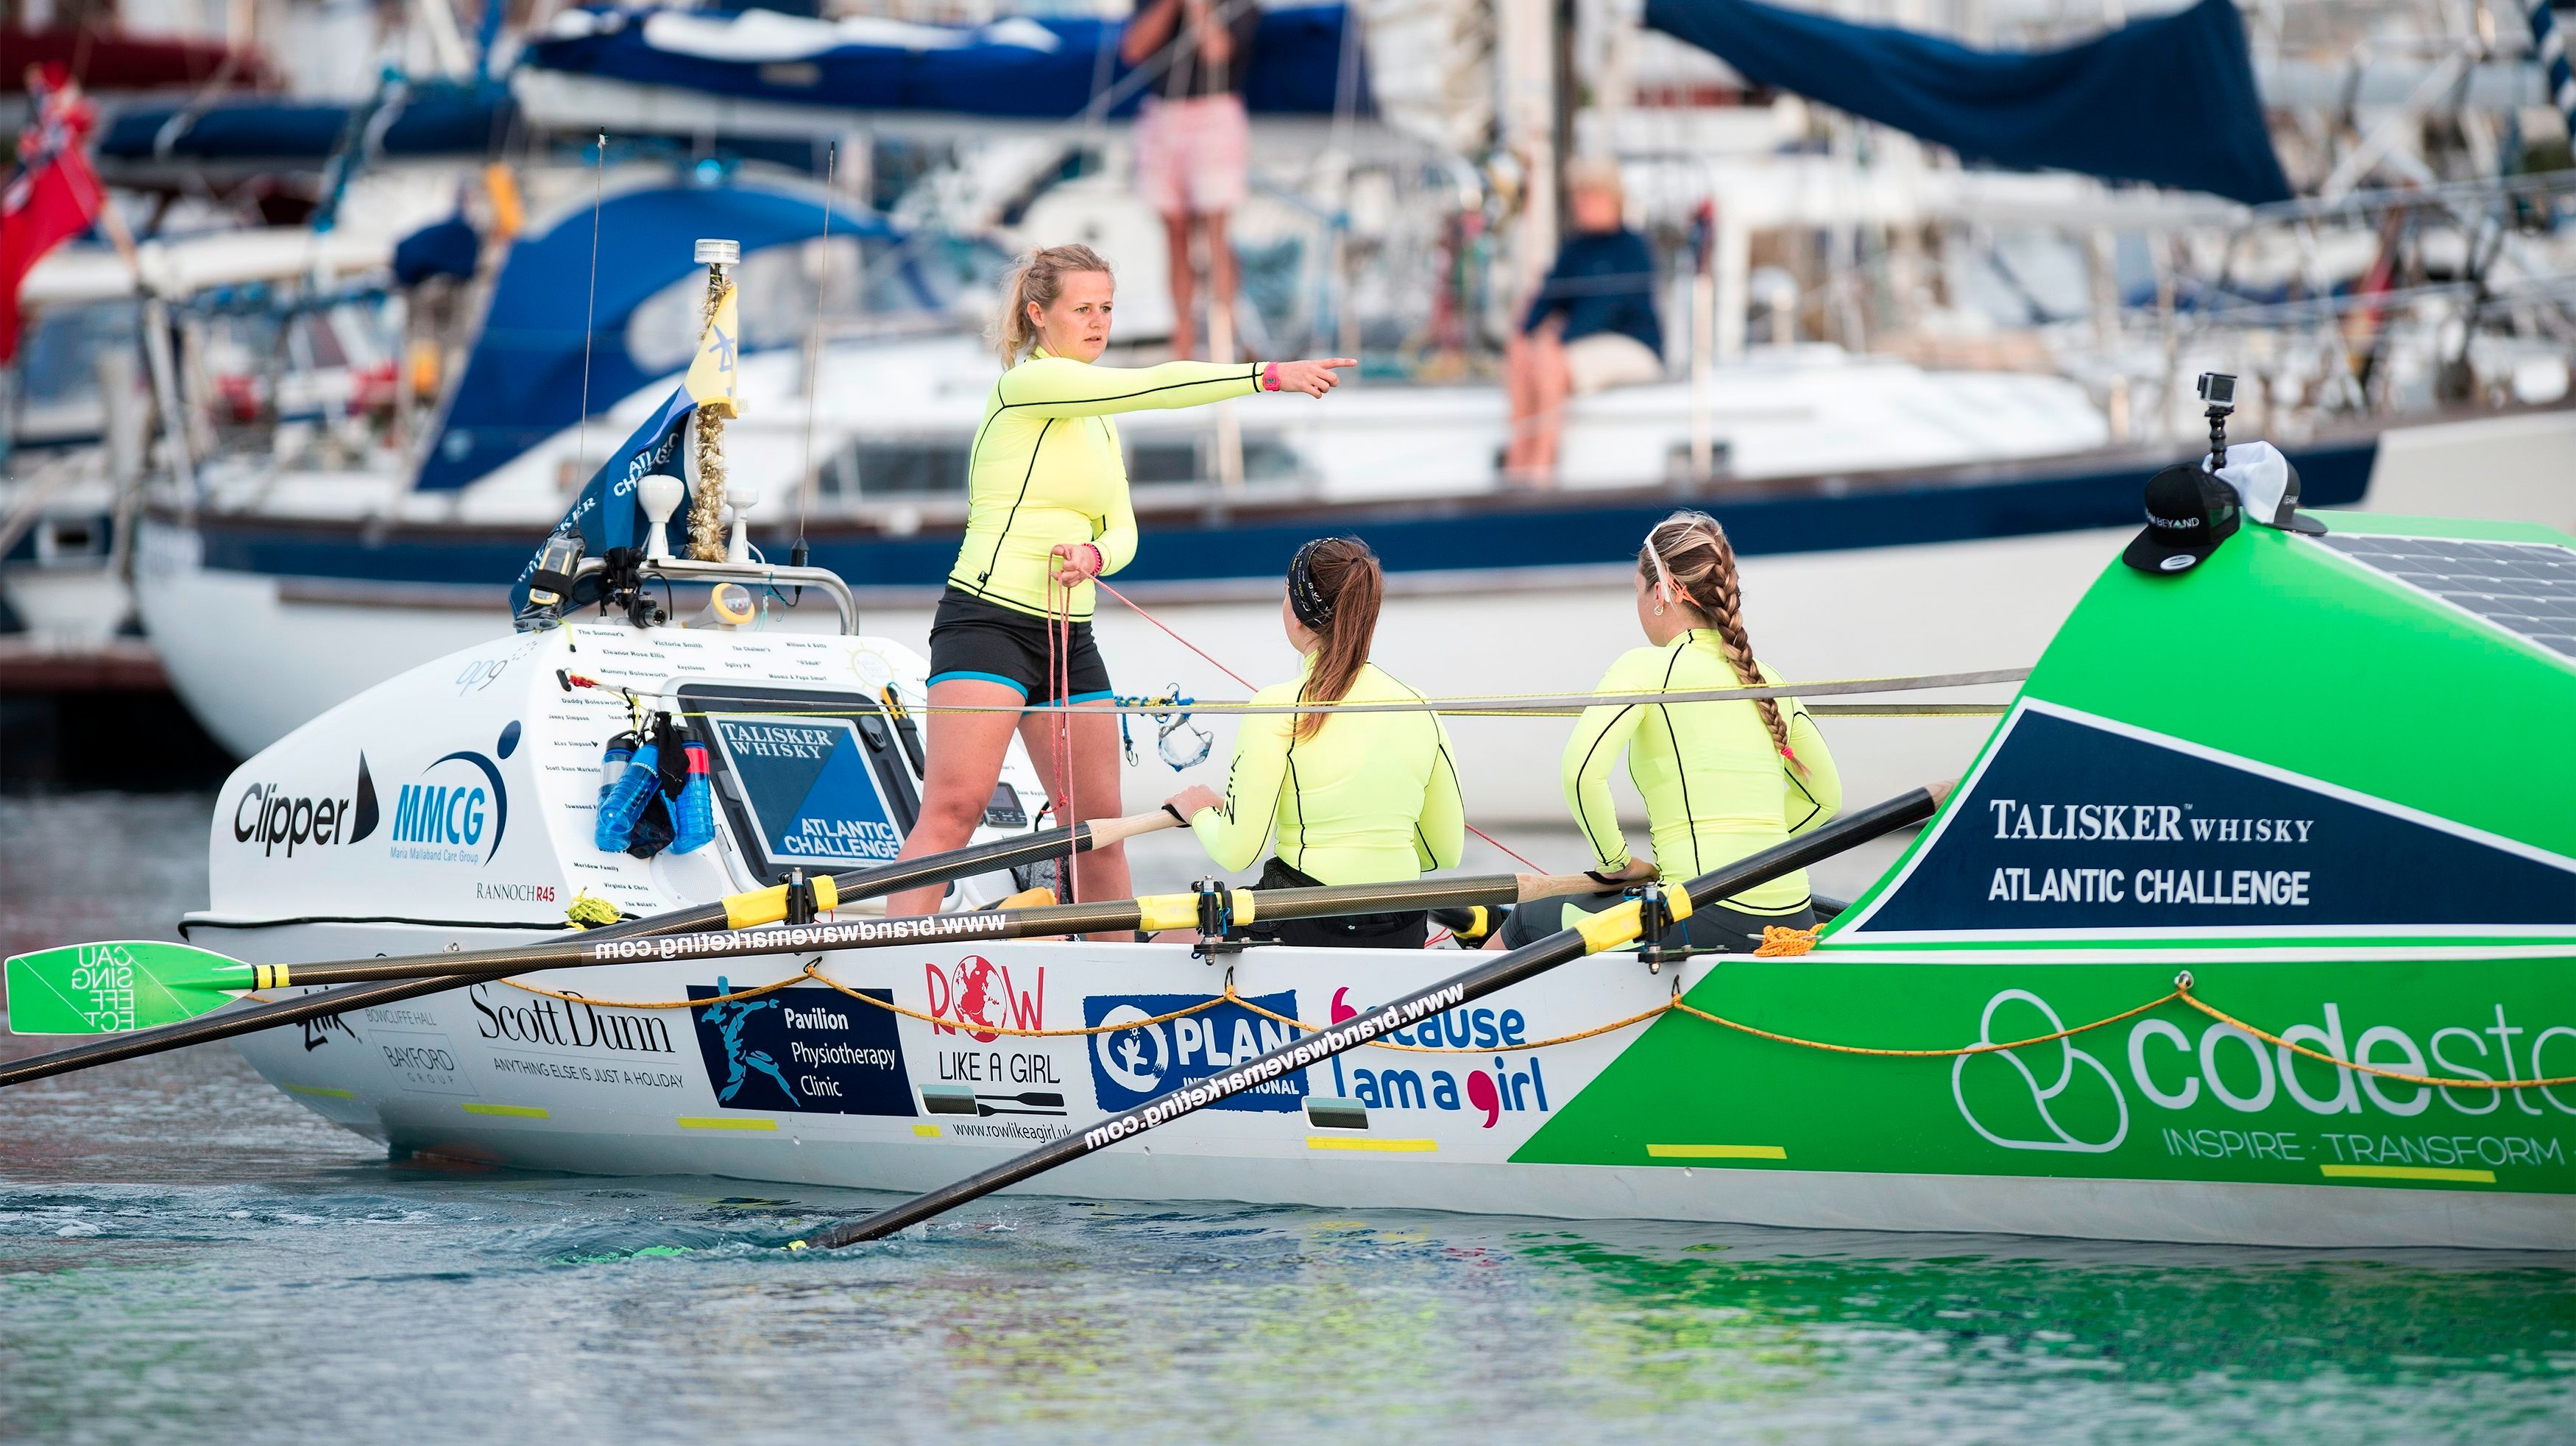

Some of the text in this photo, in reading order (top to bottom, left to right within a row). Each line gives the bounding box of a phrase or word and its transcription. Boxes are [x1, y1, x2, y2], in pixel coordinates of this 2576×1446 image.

[721, 723, 833, 746] TALISKER
[731, 741, 821, 759] WHISKY
[234, 782, 350, 858] Clipper
[392, 784, 485, 846] MMCG
[1989, 799, 2184, 842] TALISKER
[2190, 818, 2315, 843] WHISKY
[802, 818, 895, 840] ATLANTIC
[390, 847, 479, 865] Maria Mallaband Care Group
[784, 835, 900, 858] CHALLENGE
[476, 882, 555, 902] RANNOCH R45
[1988, 868, 2311, 905] ATLANTIC CHALLENGE
[365, 1008, 437, 1026] BOWCLIFFE HALL
[470, 982, 676, 1053] Scott Dunn
[784, 1007, 849, 1030] Pavilion
[1175, 1018, 1291, 1066] PLAN
[383, 1046, 455, 1071] BAYFORD
[791, 1041, 895, 1071] Physiotherapy
[939, 1052, 1061, 1084] LIKE A GIRL
[407, 1073, 454, 1085] GROUP
[494, 1057, 684, 1089] ANYTHING ELSE IS JUST A HOLIDAY
[801, 1075, 843, 1096] Clinic
[1354, 1068, 1426, 1109] am
[1432, 1070, 1461, 1110] a
[2162, 1127, 2565, 1166] INSPIRE TRANSFORM
